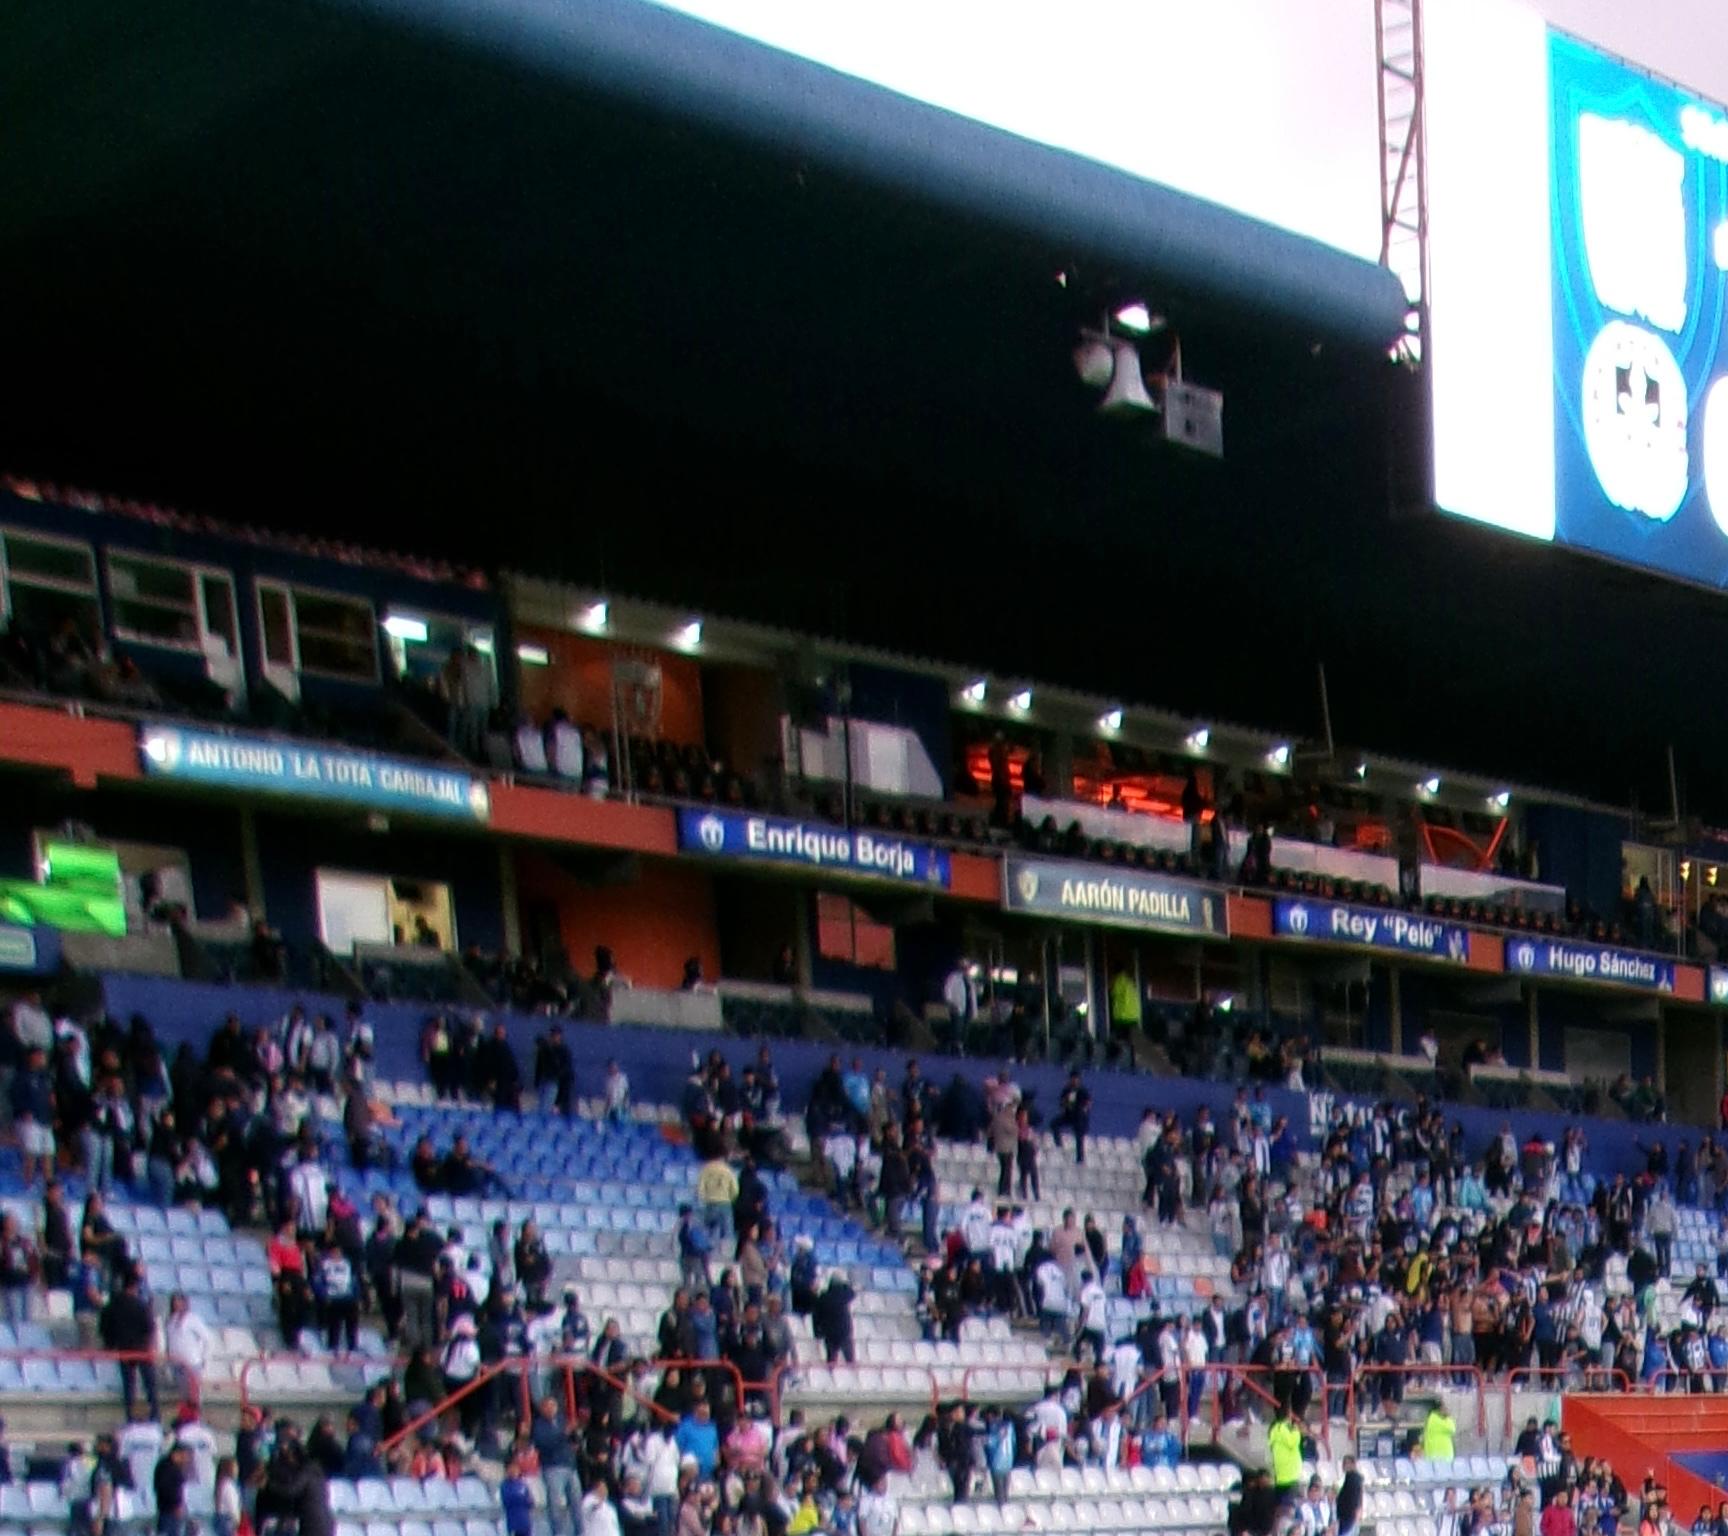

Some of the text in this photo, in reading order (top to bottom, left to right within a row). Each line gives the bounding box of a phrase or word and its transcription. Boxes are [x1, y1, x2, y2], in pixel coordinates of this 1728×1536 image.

[189, 740, 283, 776] ANTONIO
[747, 817, 914, 876] Enrique Borja
[1061, 871, 1190, 922] AARÓN PADILLA
[1331, 909, 1377, 944] Rey
[1549, 946, 1655, 979] Hugo Sánchez
